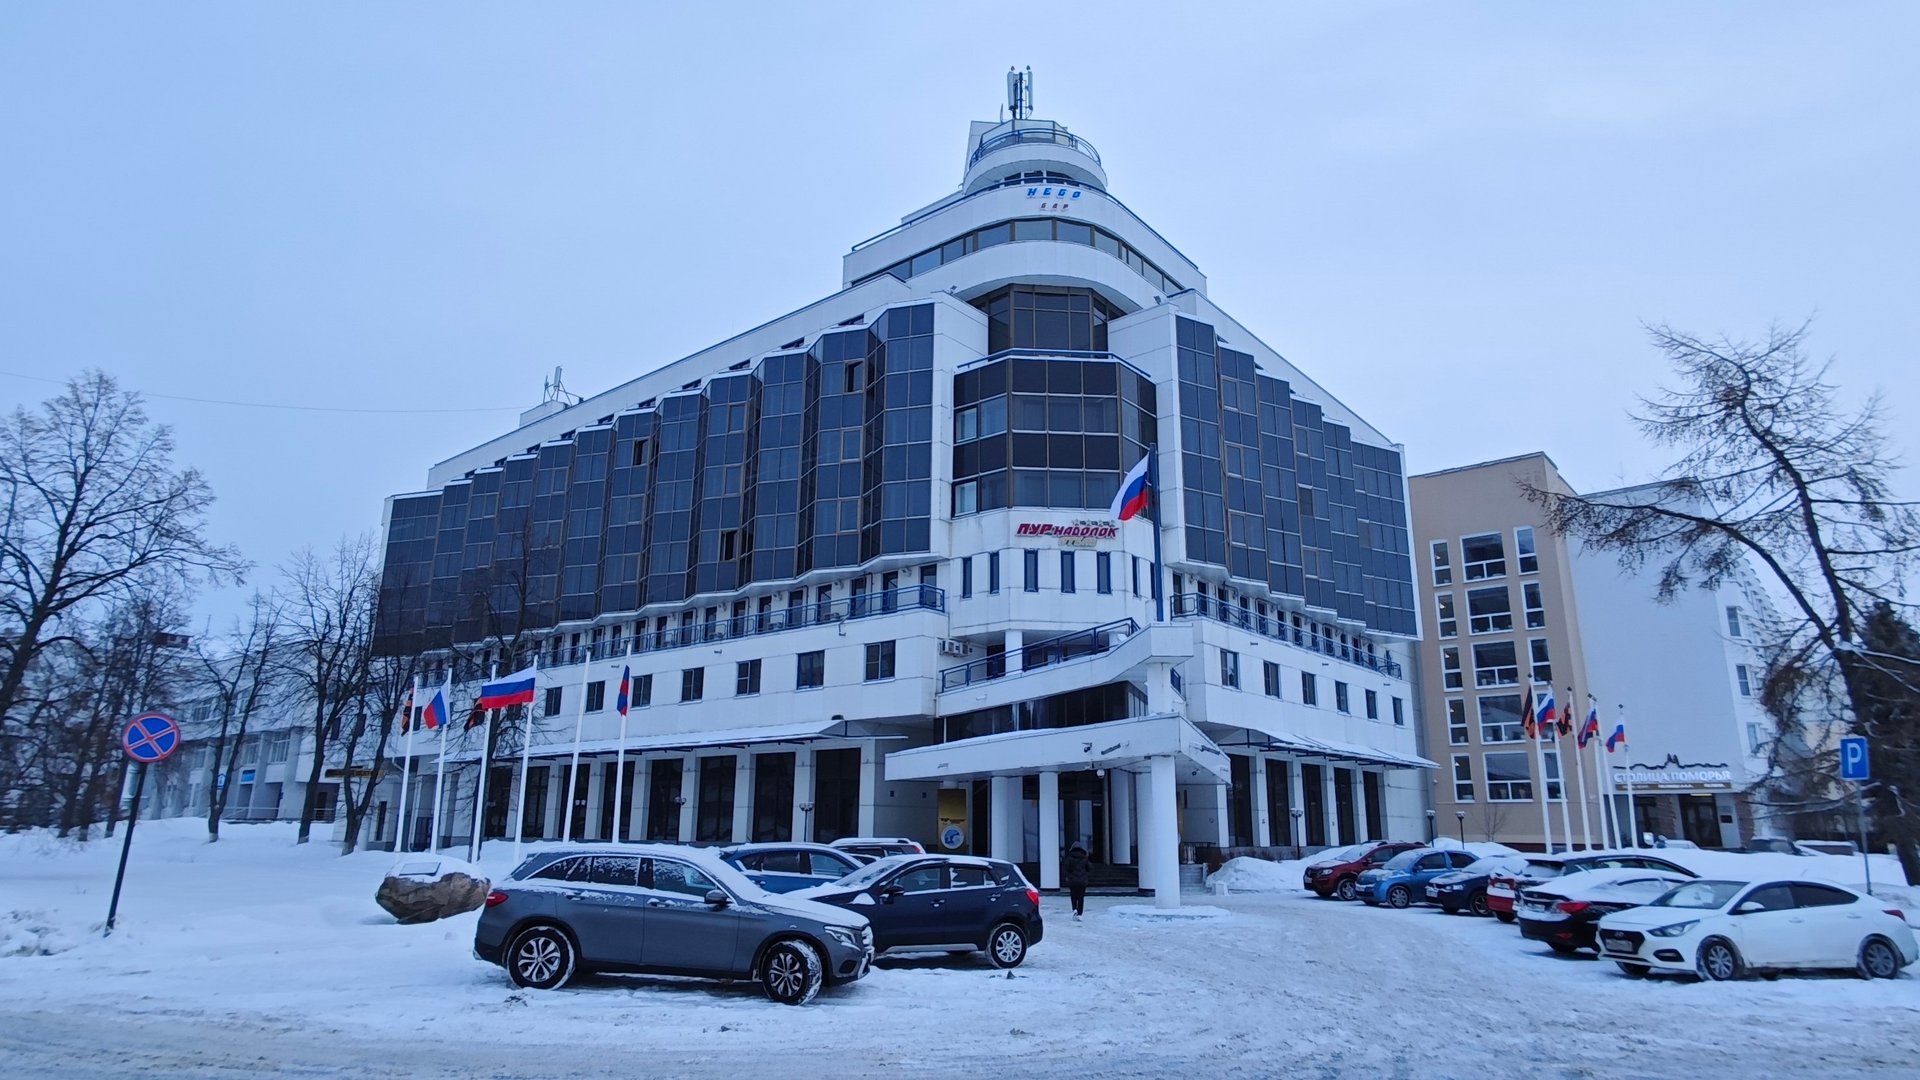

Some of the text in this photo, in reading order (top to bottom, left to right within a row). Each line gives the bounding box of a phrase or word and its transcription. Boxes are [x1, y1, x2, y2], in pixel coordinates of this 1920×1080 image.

[1027, 187, 1081, 198] НЕБО
[1846, 742, 1862, 775] P
[1613, 770, 1732, 783] СТОЛИЦА ПОМОРЬЯ
